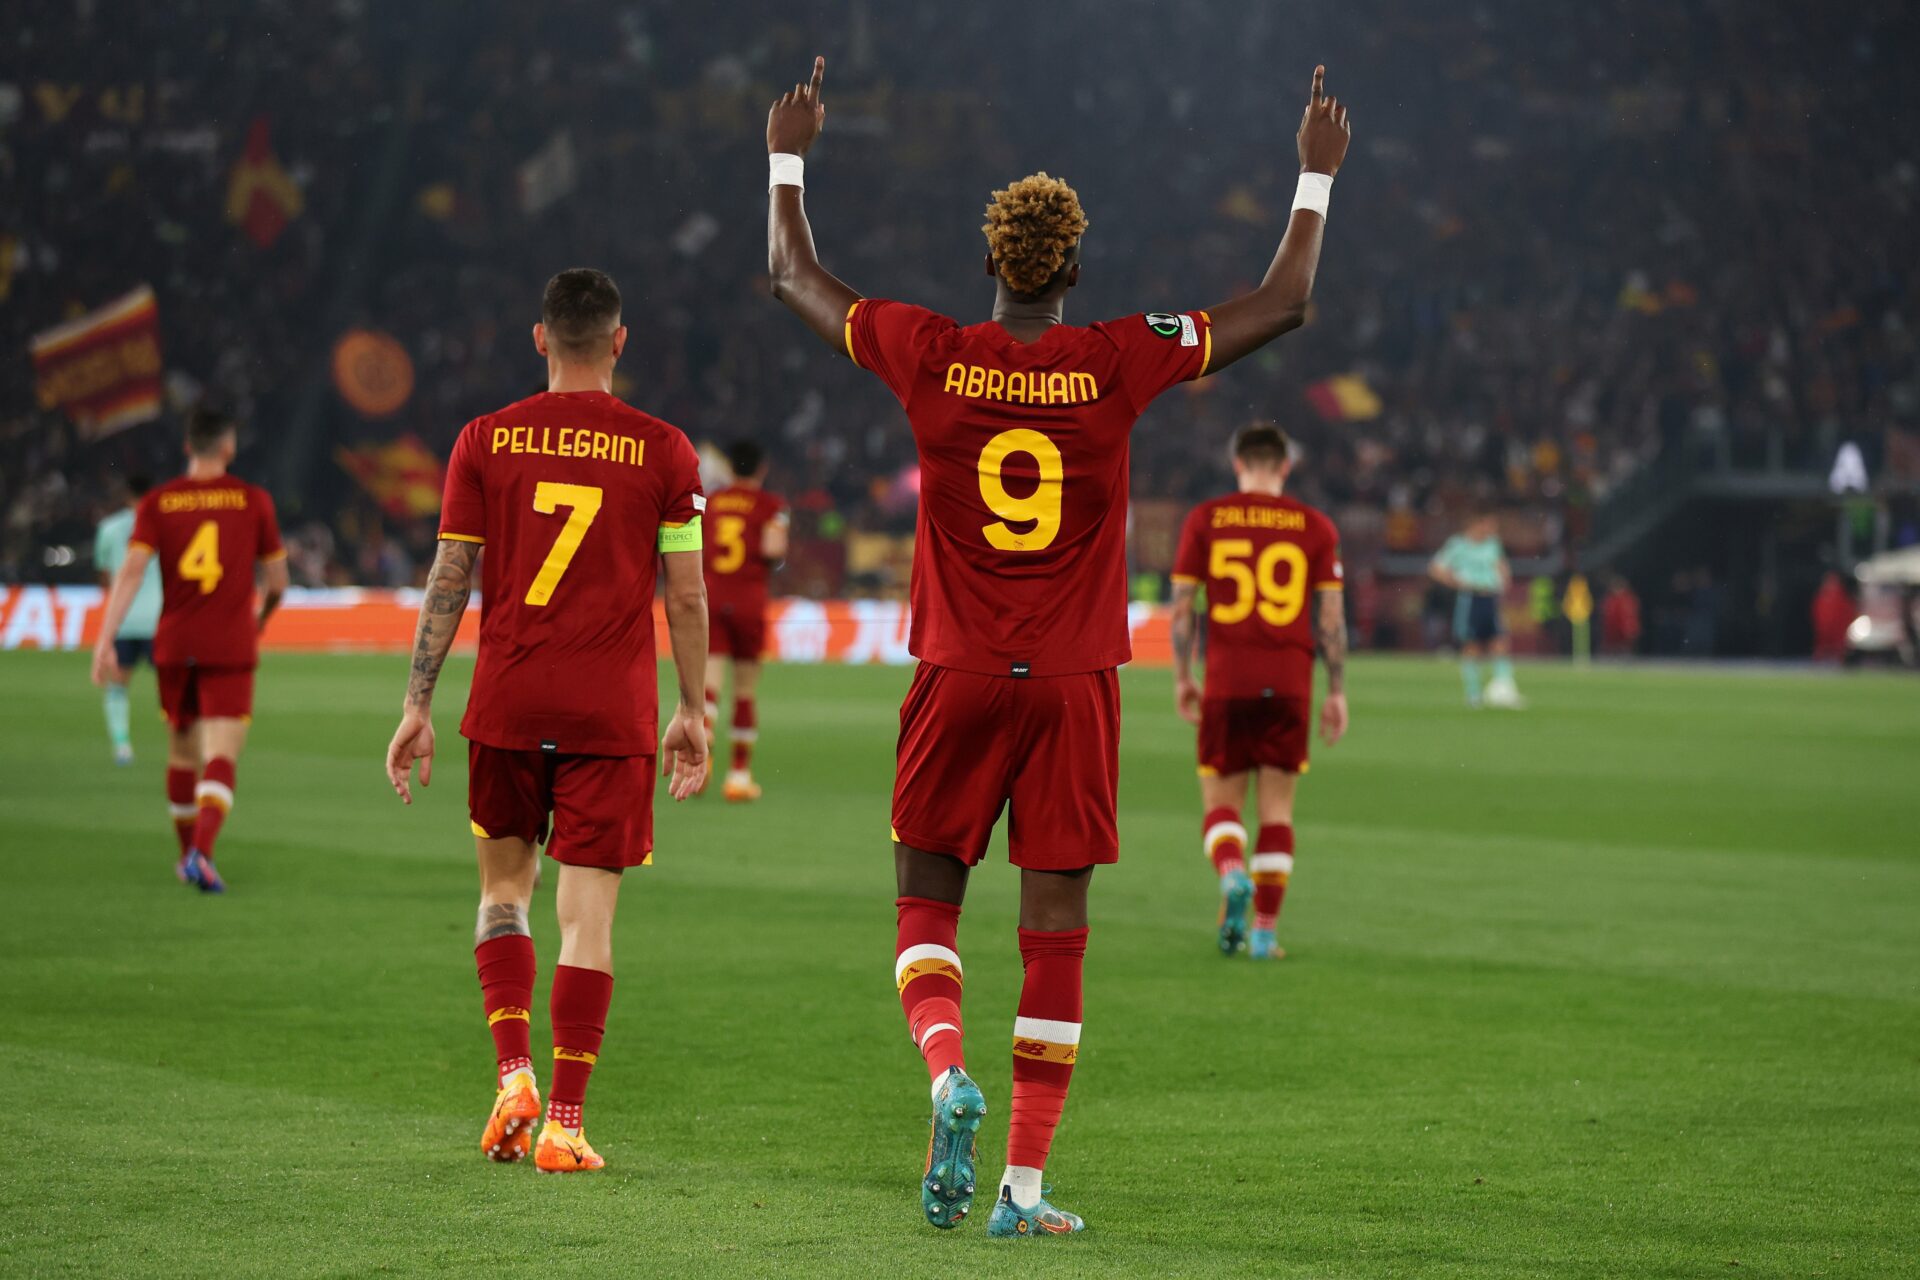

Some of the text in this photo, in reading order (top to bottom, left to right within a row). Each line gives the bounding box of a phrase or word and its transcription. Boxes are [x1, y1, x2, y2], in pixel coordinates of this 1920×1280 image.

[944, 362, 1098, 404] ABRAHAM
[492, 426, 645, 467] PELLEGRINI
[978, 428, 1064, 551] 9
[1211, 505, 1305, 531] ZALEWSKI
[178, 520, 223, 595] 4
[524, 481, 604, 606] 7
[664, 533, 693, 541] RESPECT
[711, 516, 747, 574] 3
[1209, 539, 1308, 627] 59
[0, 585, 105, 650] AT
